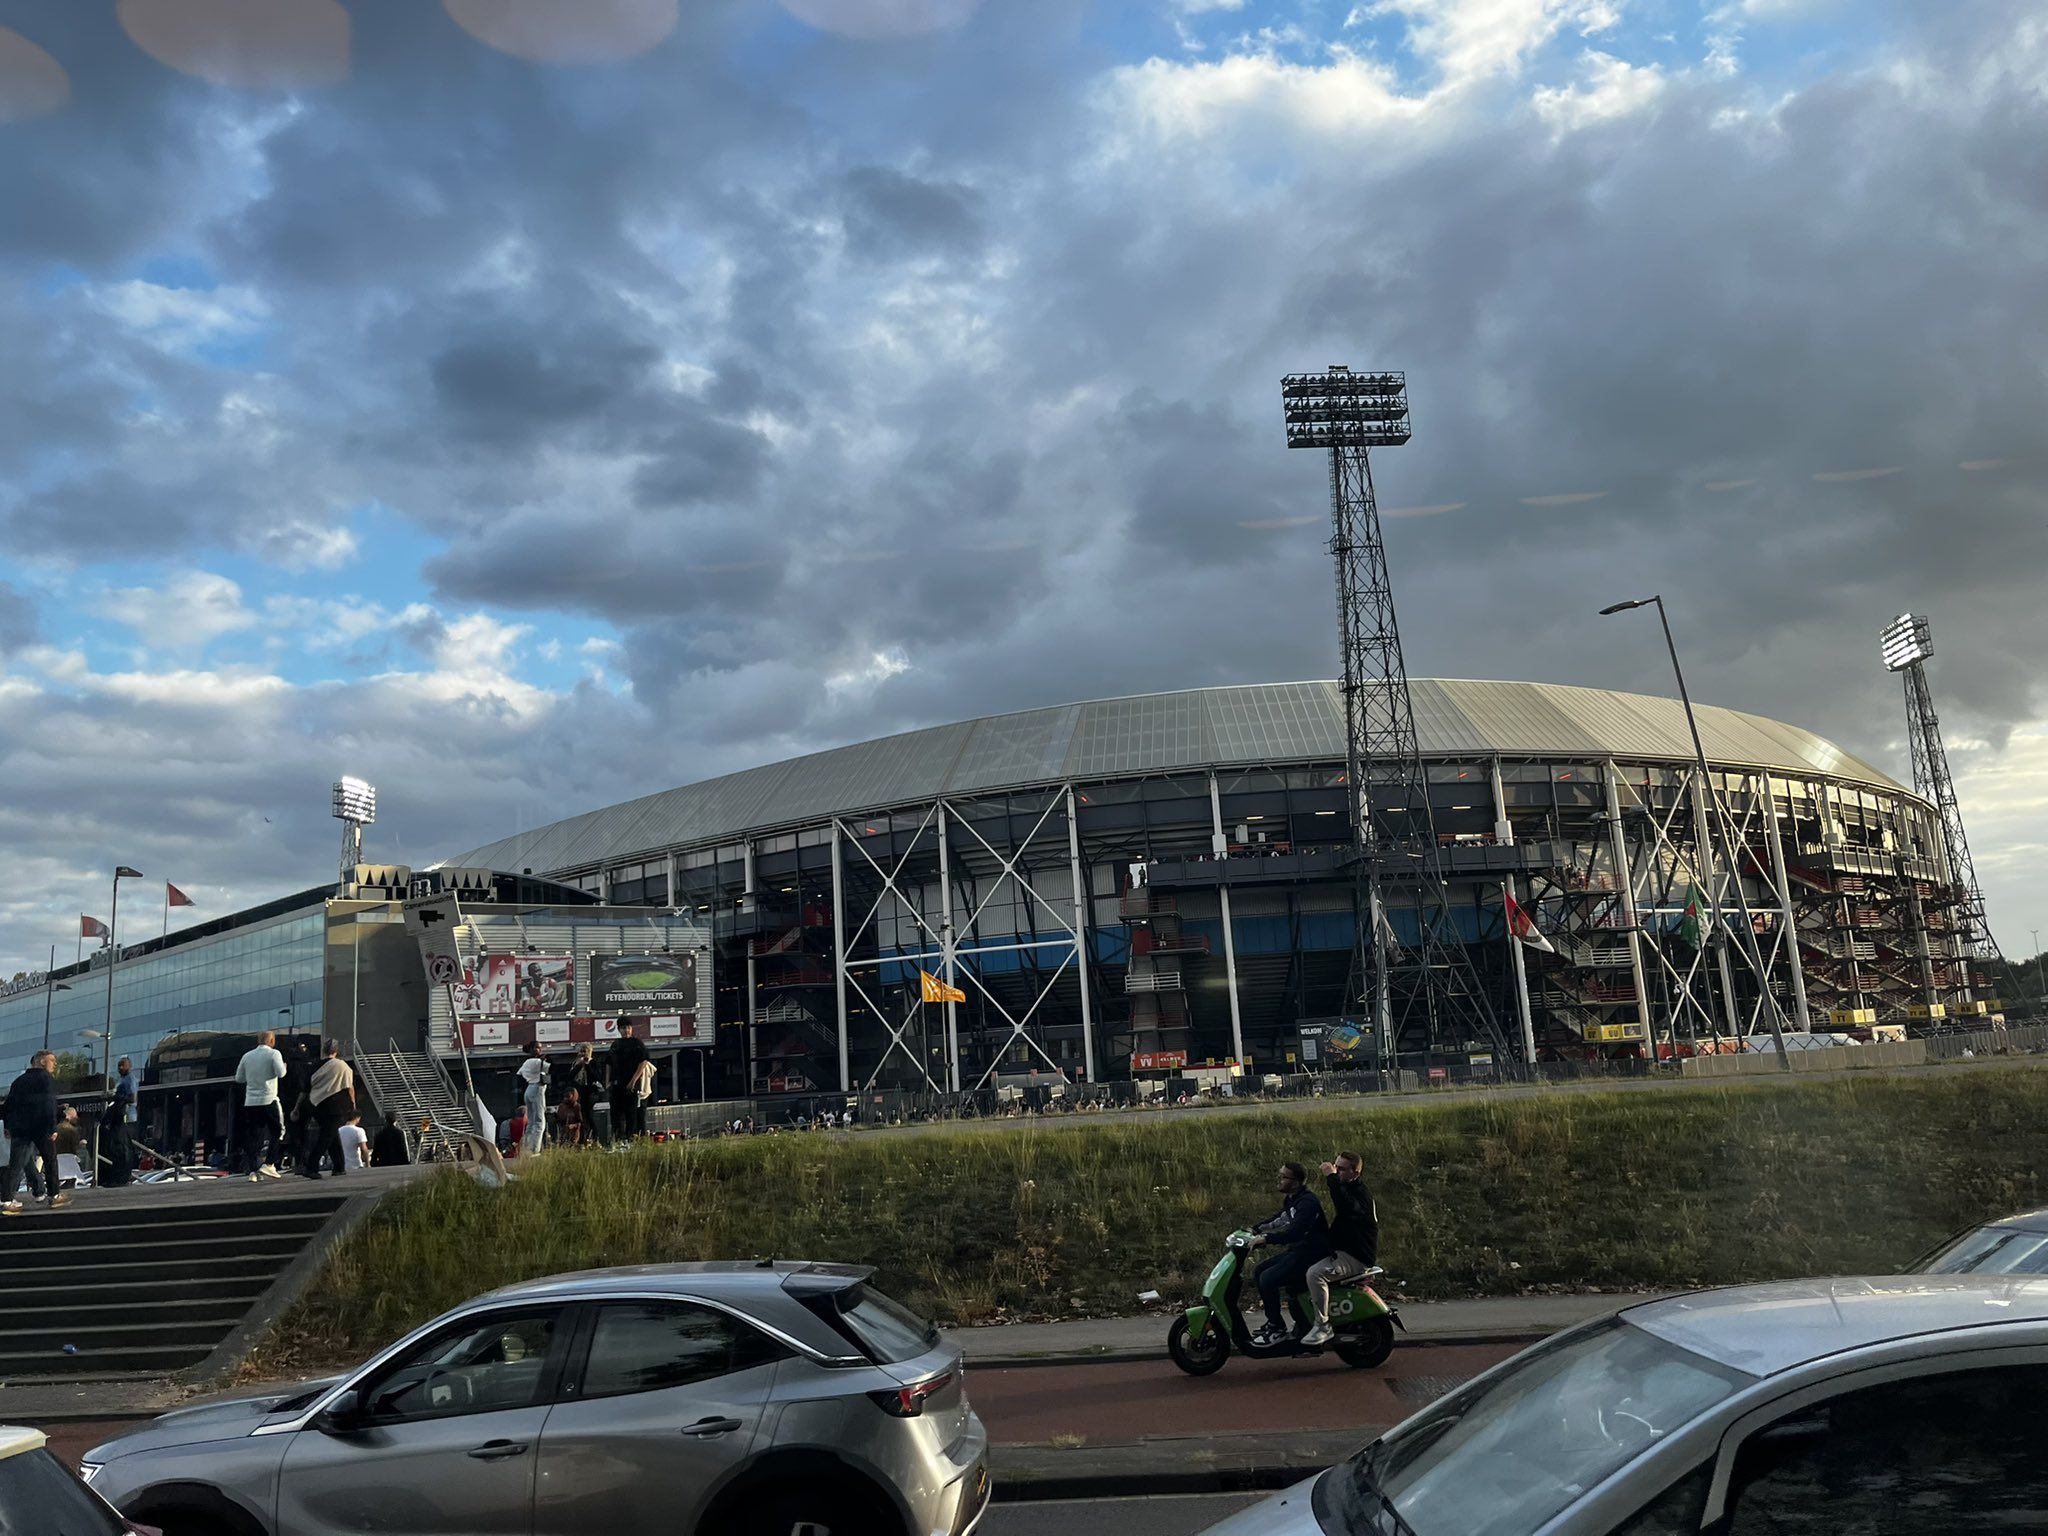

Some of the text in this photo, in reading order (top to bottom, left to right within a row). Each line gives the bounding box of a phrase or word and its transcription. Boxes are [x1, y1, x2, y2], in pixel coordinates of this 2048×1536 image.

[605, 992, 684, 1002] FEYENOORD.NL/TICKETS
[1300, 1027, 1322, 1035] WELKOM
[1329, 1299, 1354, 1317] GO
